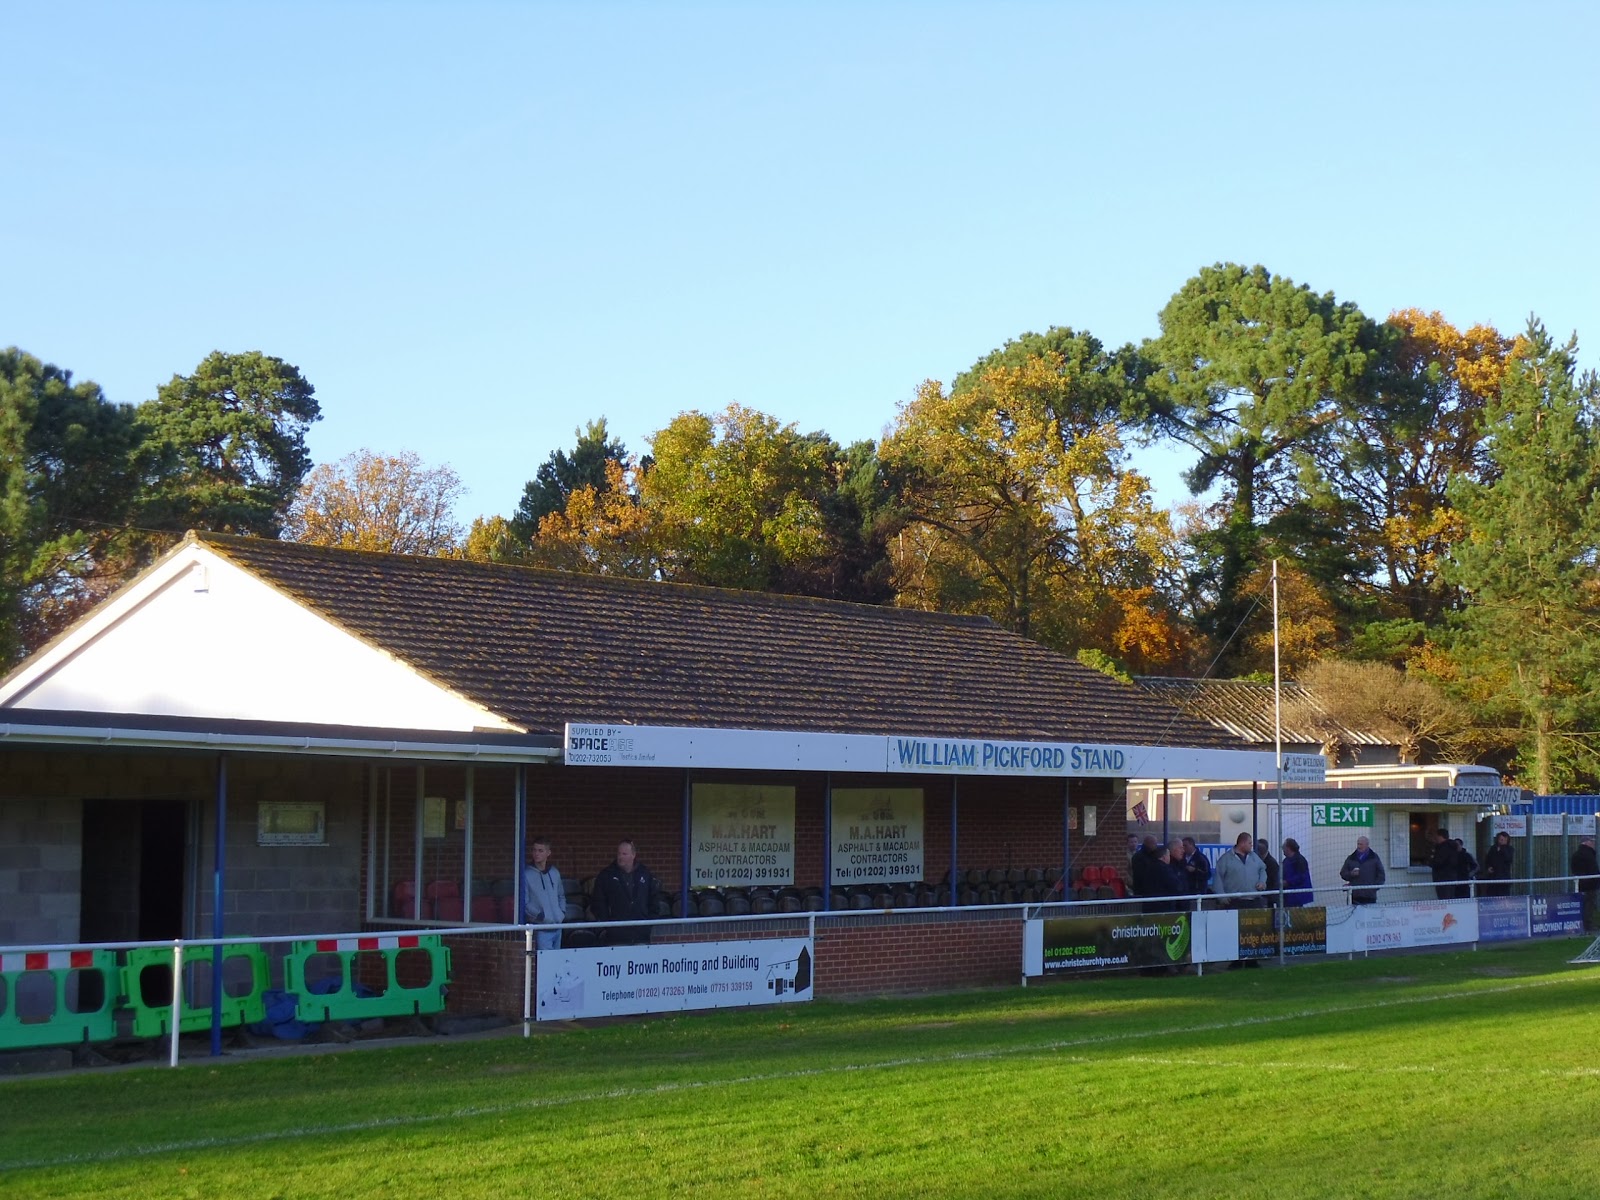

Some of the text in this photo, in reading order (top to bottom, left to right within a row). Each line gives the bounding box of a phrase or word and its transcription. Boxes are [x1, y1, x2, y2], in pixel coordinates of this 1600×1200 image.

[571, 727, 604, 736] SUPPLIED
[897, 739, 1124, 770] WILLIAM PICKFORD STAND
[1450, 787, 1519, 803] REFRESHMENTS
[1329, 806, 1370, 823] EXIT
[698, 842, 790, 853] ASPHALT & MACADAM
[837, 841, 920, 853] ASPHALT & MACADAM
[712, 854, 777, 865] CONTRACTORS
[850, 853, 908, 865] CONTRACTORS
[695, 867, 791, 880] Tel: (01202) 391931
[835, 865, 920, 879] Tel: (01202) 391931
[1112, 924, 1181, 939] christchurchtyreco
[1533, 921, 1563, 933] EMPLOYMENT
[1563, 920, 1581, 930] AGENCY
[1239, 931, 1260, 948] bridge
[1260, 932, 1281, 944] denta
[1045, 948, 1053, 957] tel
[1054, 946, 1073, 956] 01202
[596, 954, 759, 979] Tony Brown Roofing and Building
[1044, 954, 1129, 969] www.christchurchtyre.co.uk
[602, 981, 753, 1002] Telephone (01202) 473263 Mobile 07751 339159
